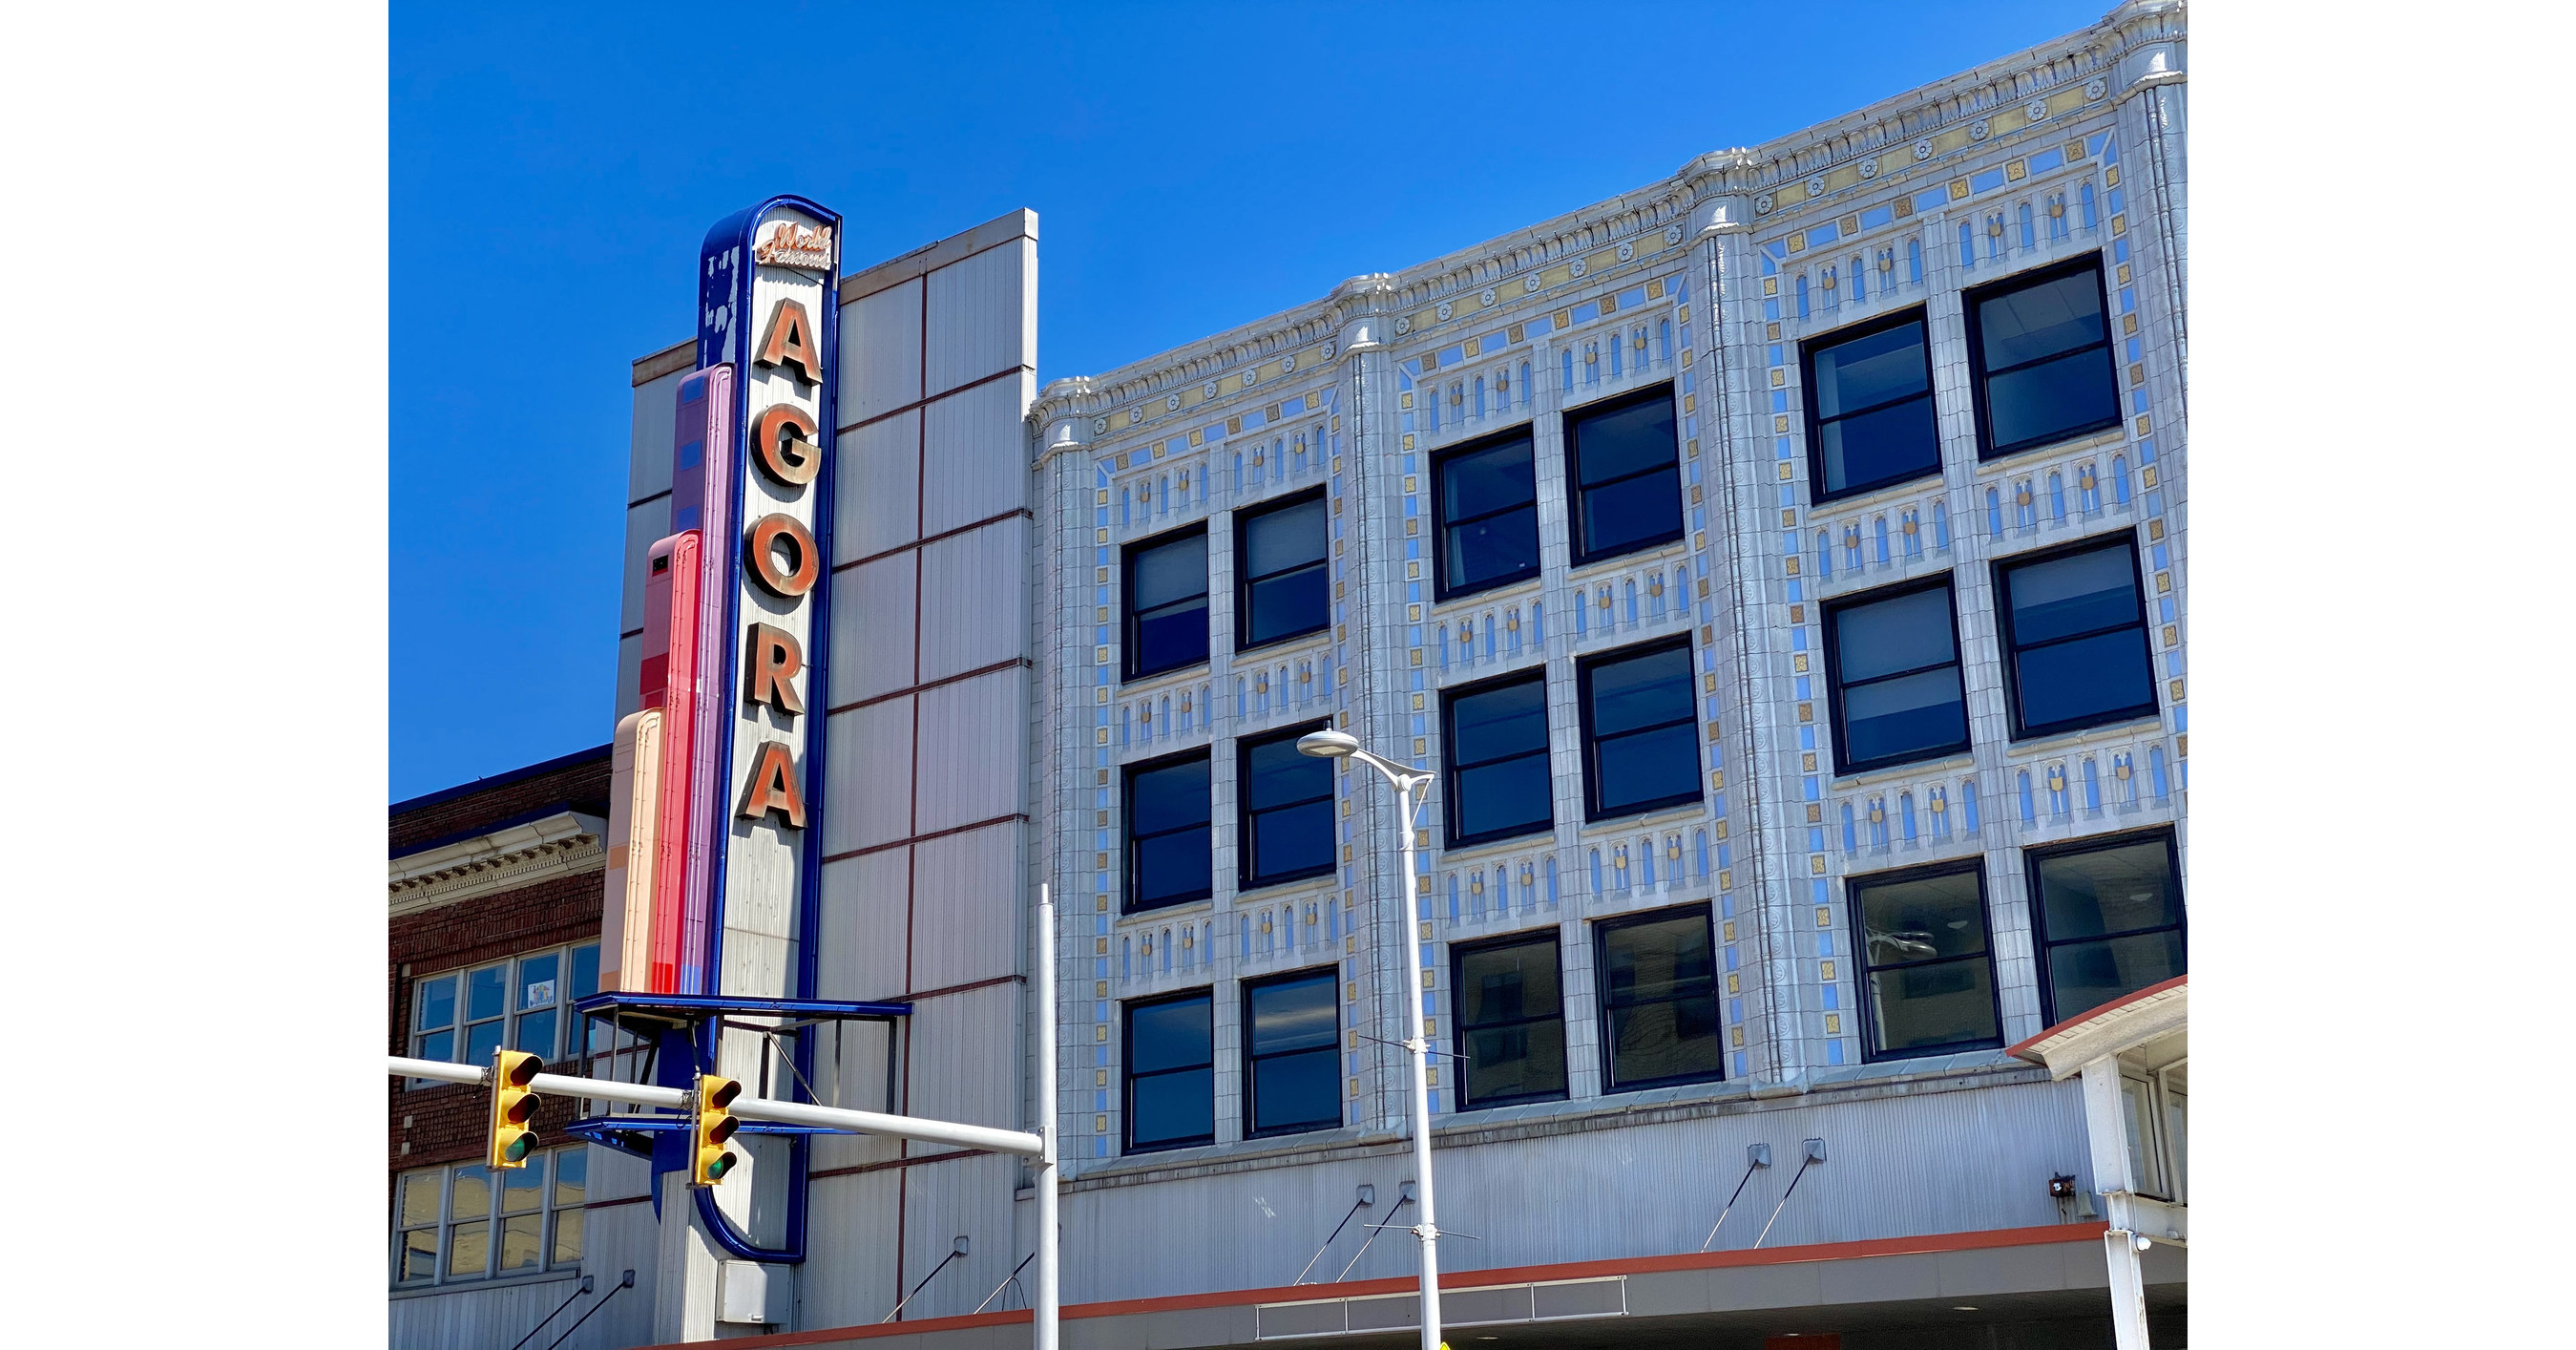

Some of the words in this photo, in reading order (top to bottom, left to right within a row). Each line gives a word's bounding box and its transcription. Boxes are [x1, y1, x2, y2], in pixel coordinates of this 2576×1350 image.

[774, 221, 832, 250] World
[758, 239, 831, 267] Famous
[736, 298, 822, 831] AGORA
